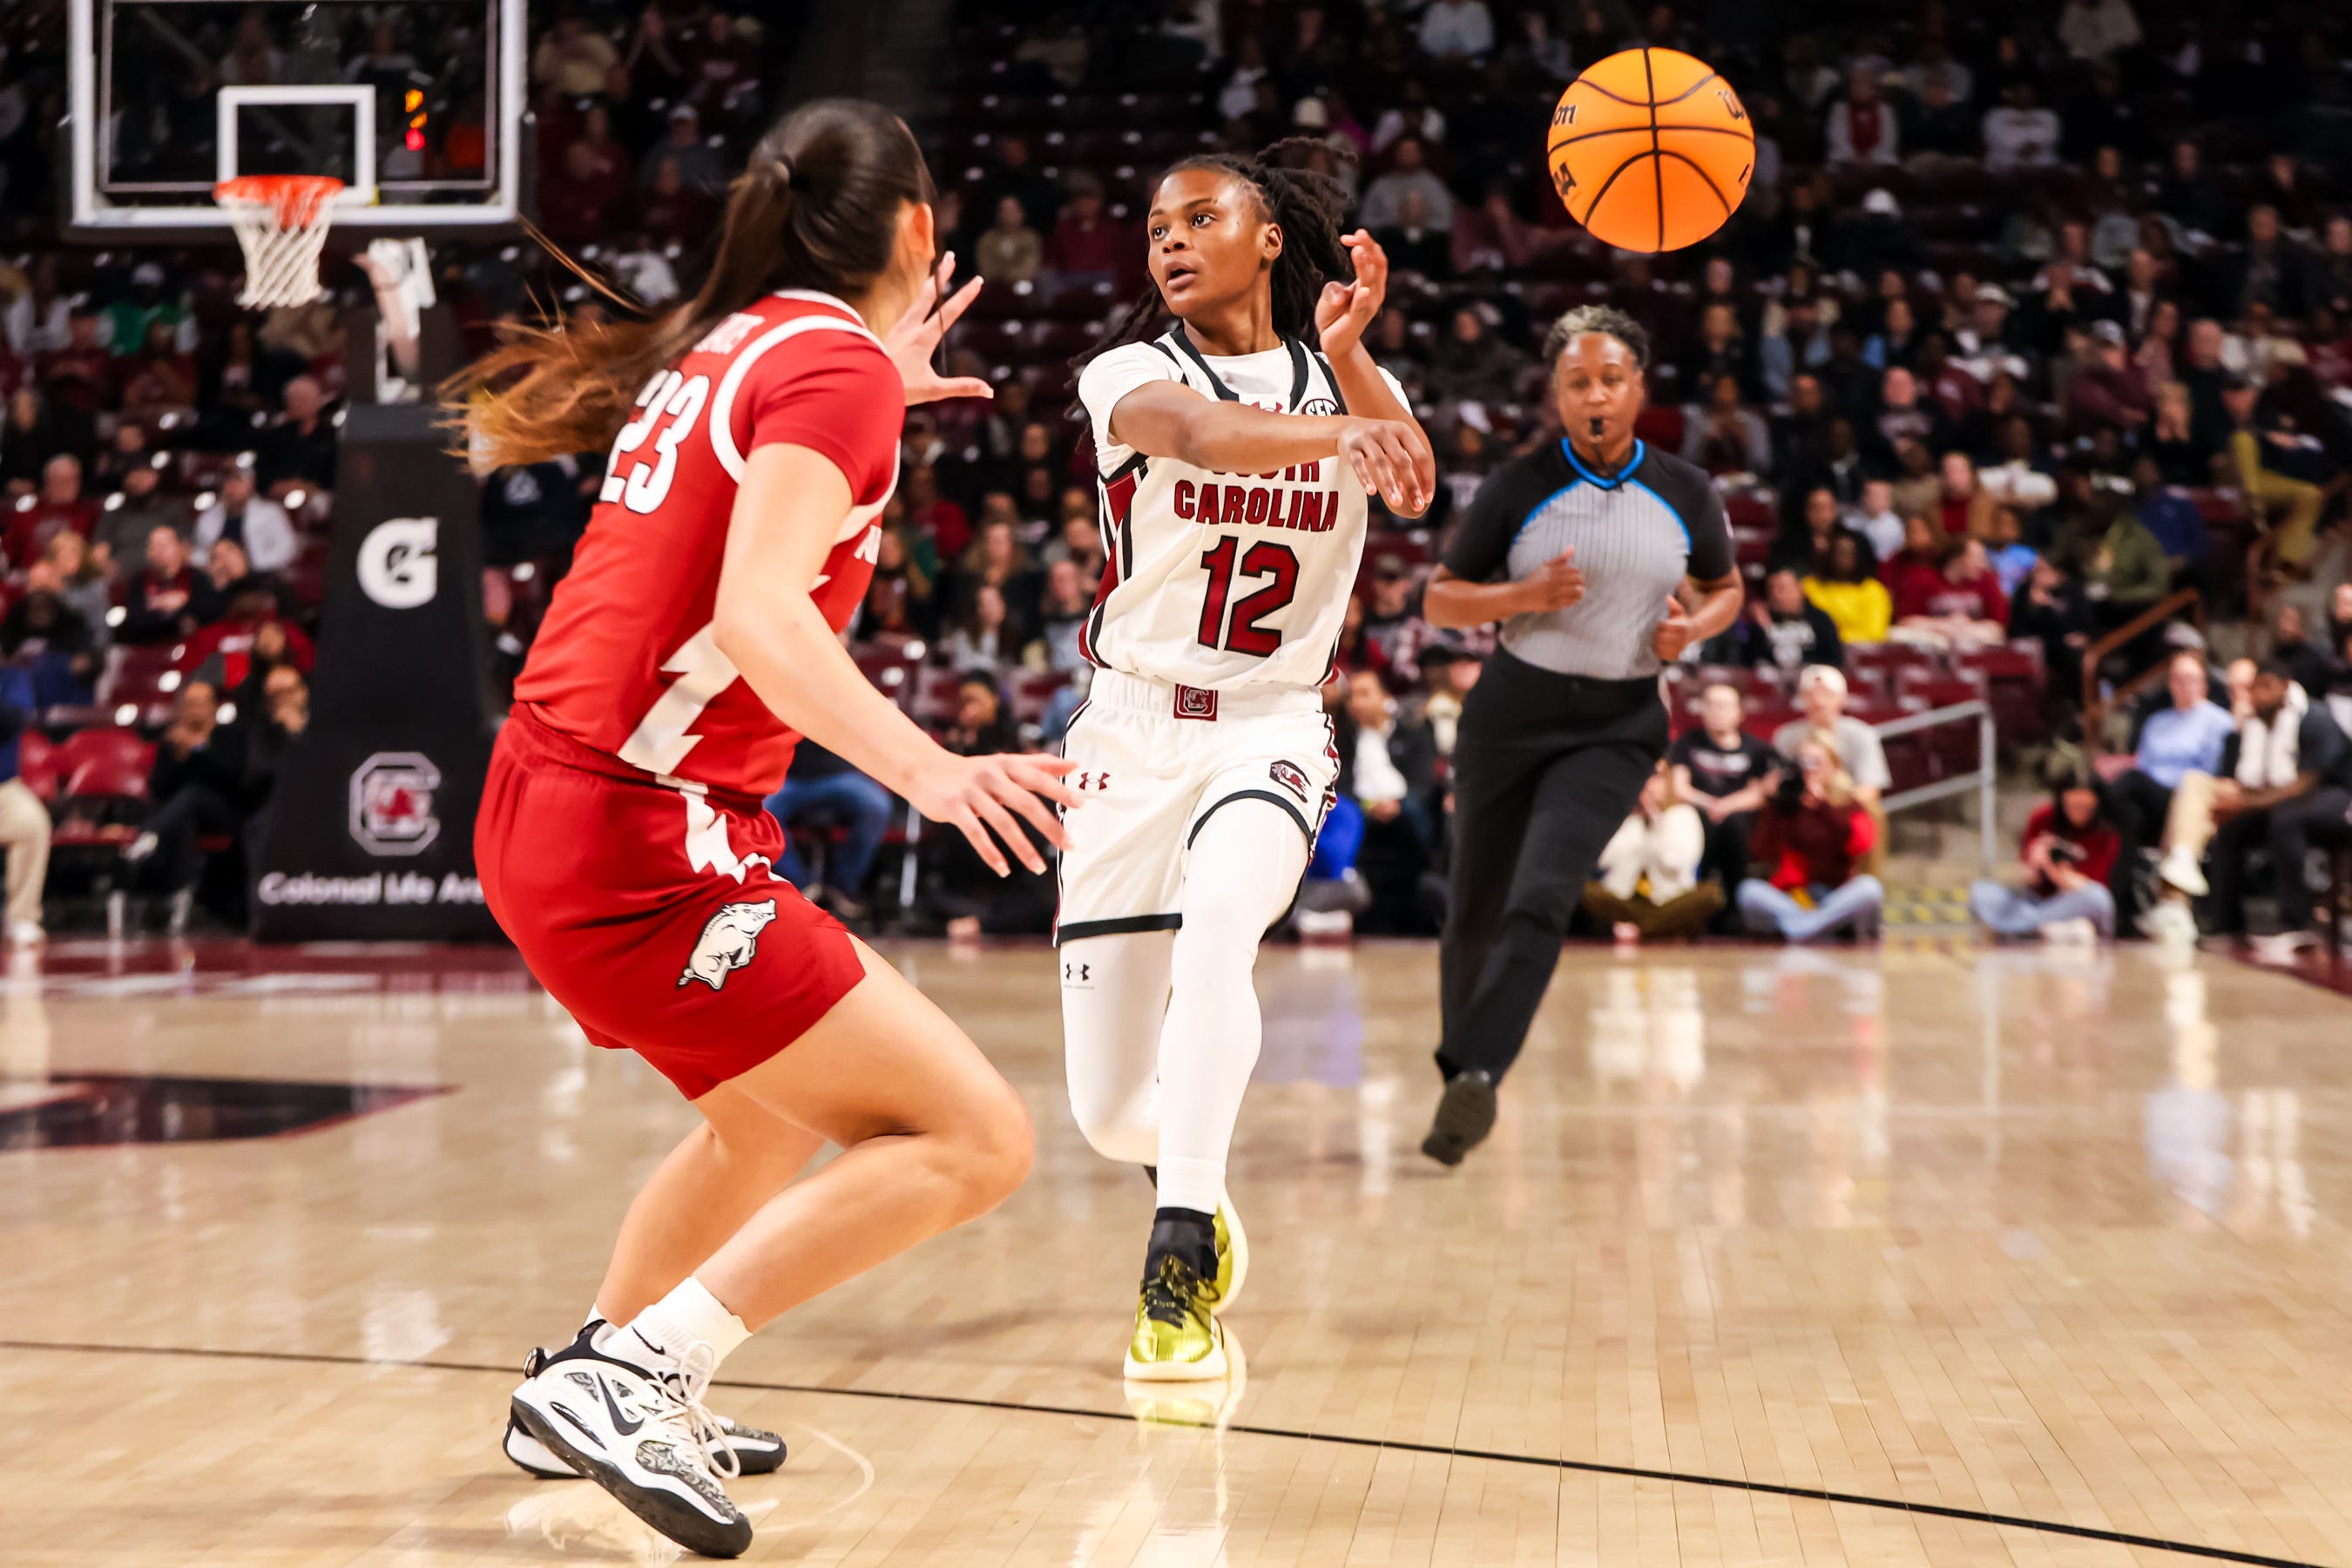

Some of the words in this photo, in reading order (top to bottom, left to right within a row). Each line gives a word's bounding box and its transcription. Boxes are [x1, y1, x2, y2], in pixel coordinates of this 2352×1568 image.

[599, 368, 710, 514] 23
[1174, 479, 1339, 532] CAROLINA
[356, 516, 438, 608] G
[1198, 535, 1300, 658] 12
[258, 872, 382, 904] Colonial
[383, 872, 436, 904] Life
[437, 871, 486, 904] Are
